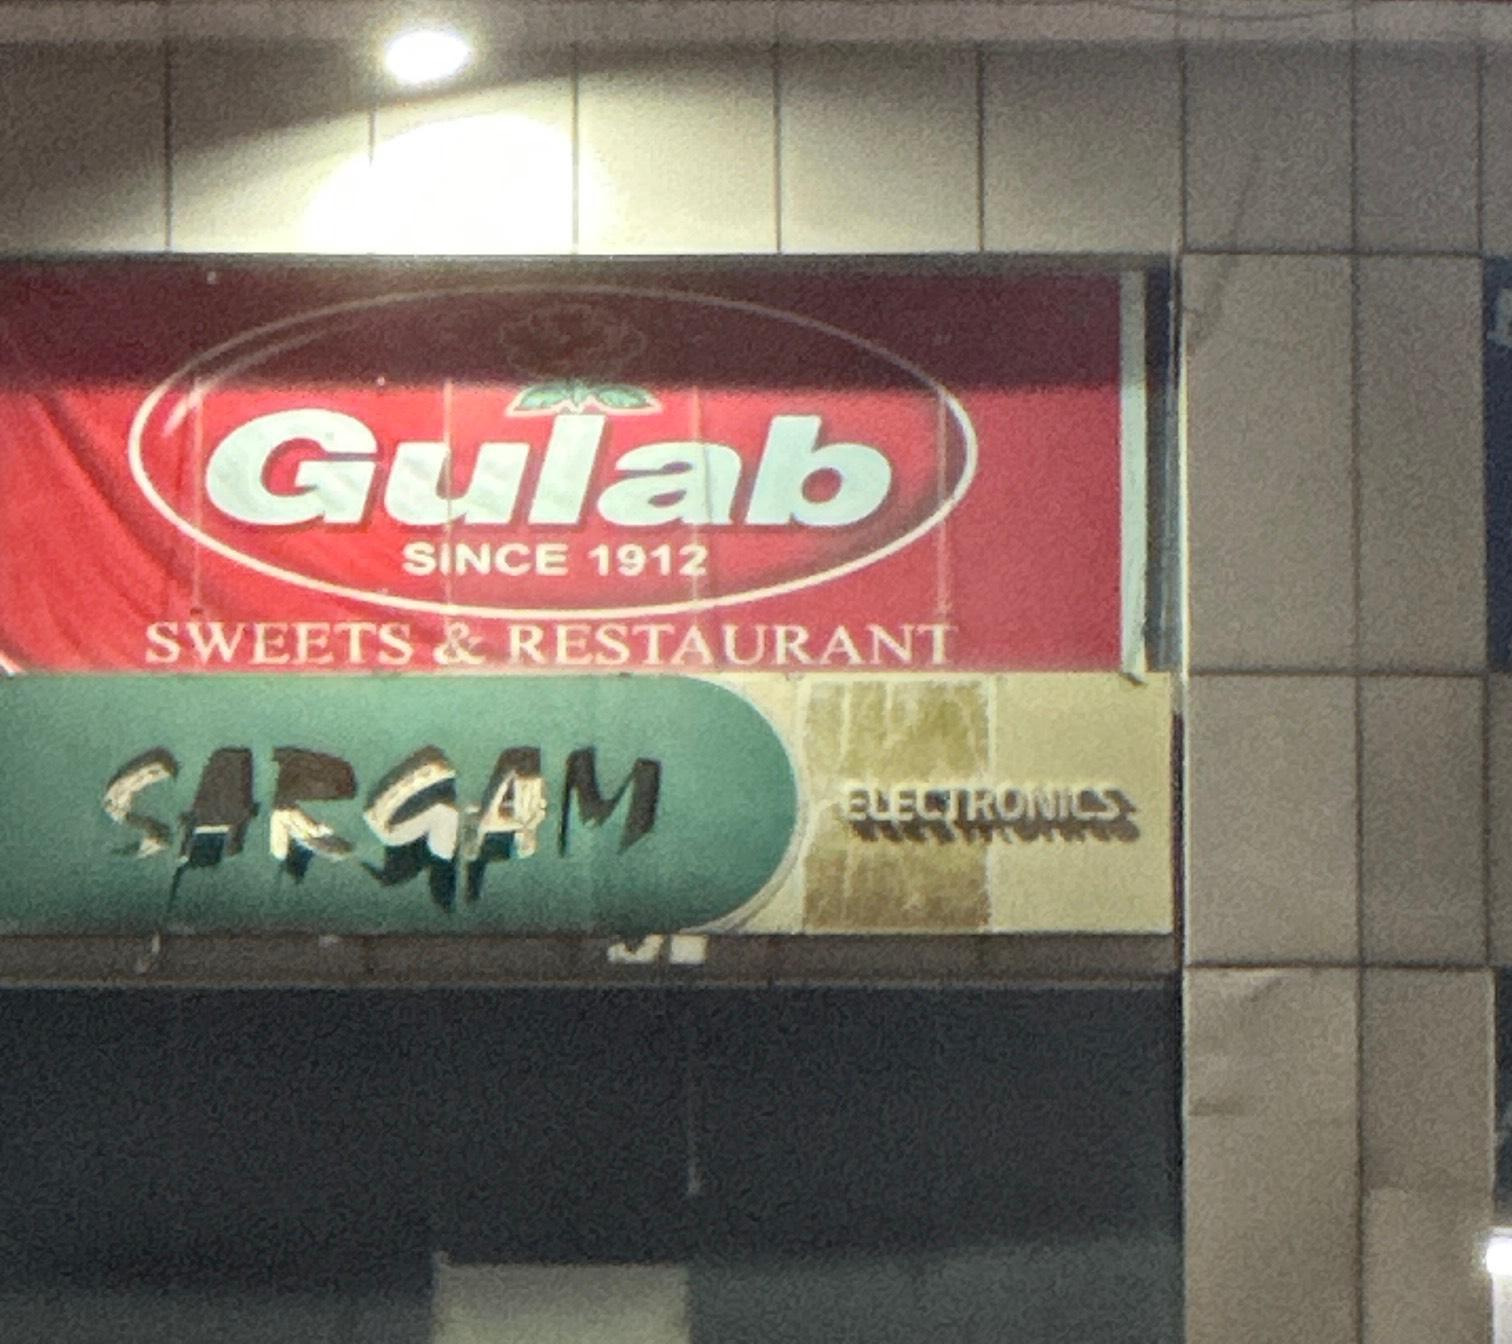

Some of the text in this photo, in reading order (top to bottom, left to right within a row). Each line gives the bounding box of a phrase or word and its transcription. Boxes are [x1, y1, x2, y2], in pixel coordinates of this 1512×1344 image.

[204, 408, 893, 527] Gulab
[401, 542, 709, 578] SINCE 1912
[145, 620, 959, 667] SWEETS & RESTAURANT
[103, 745, 661, 861] SARGAM
[844, 786, 1121, 821] ELECTRONICS
